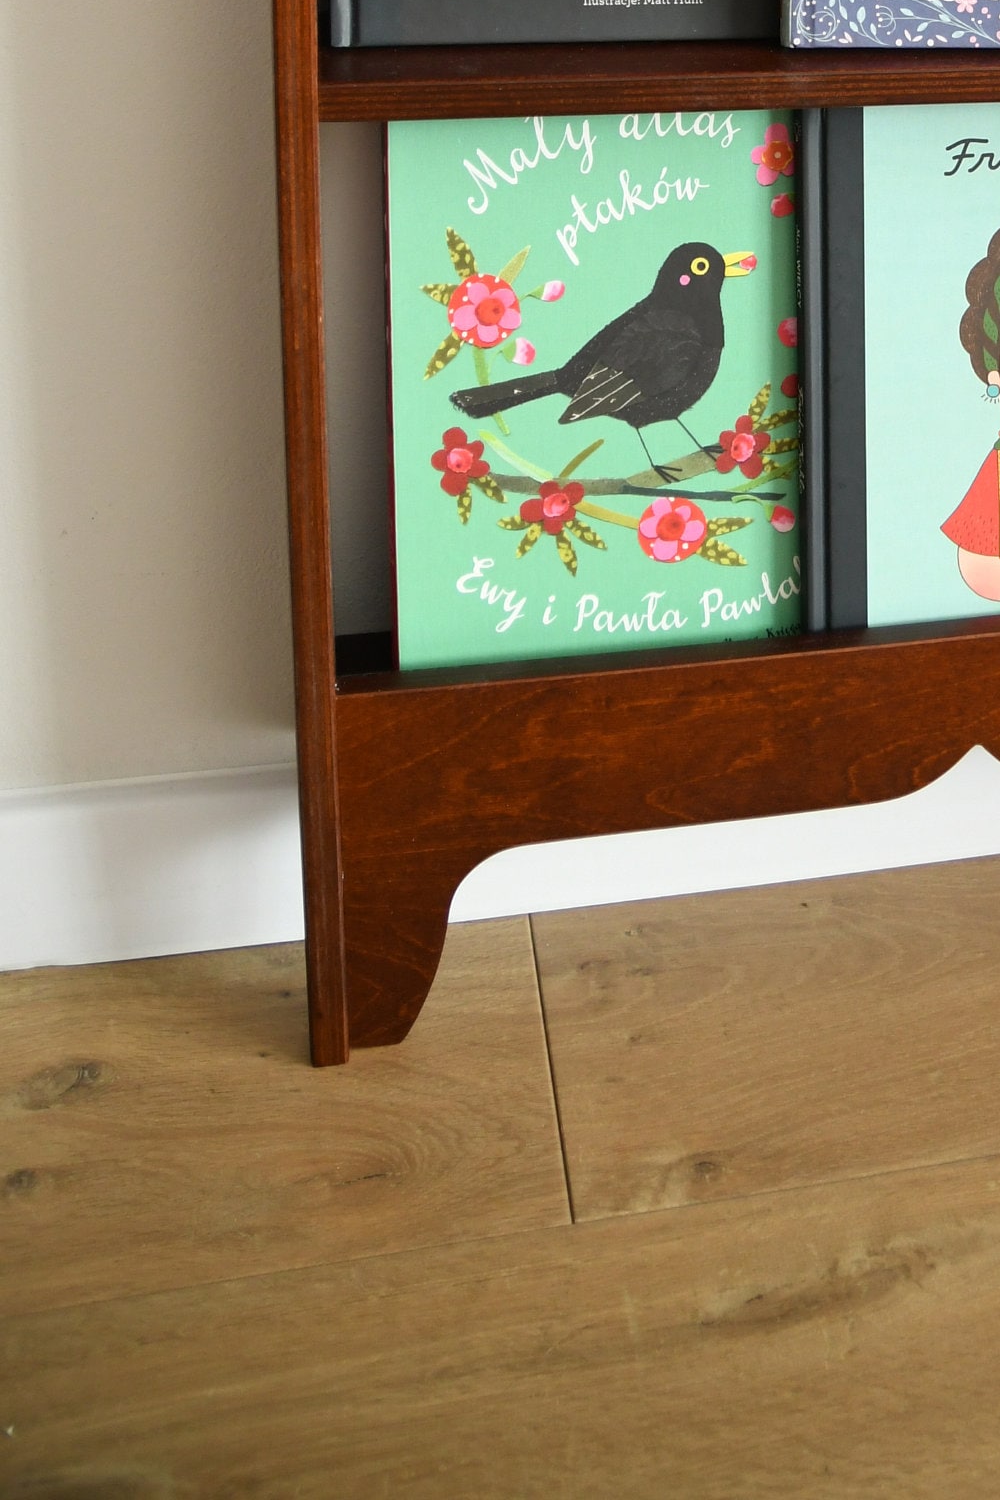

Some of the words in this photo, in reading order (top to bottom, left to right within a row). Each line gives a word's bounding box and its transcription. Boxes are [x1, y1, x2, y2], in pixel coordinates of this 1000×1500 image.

[556, 166, 710, 266] ptaków
[456, 556, 527, 633] Ewy
[542, 596, 557, 625] i
[573, 591, 688, 633] Pawła
